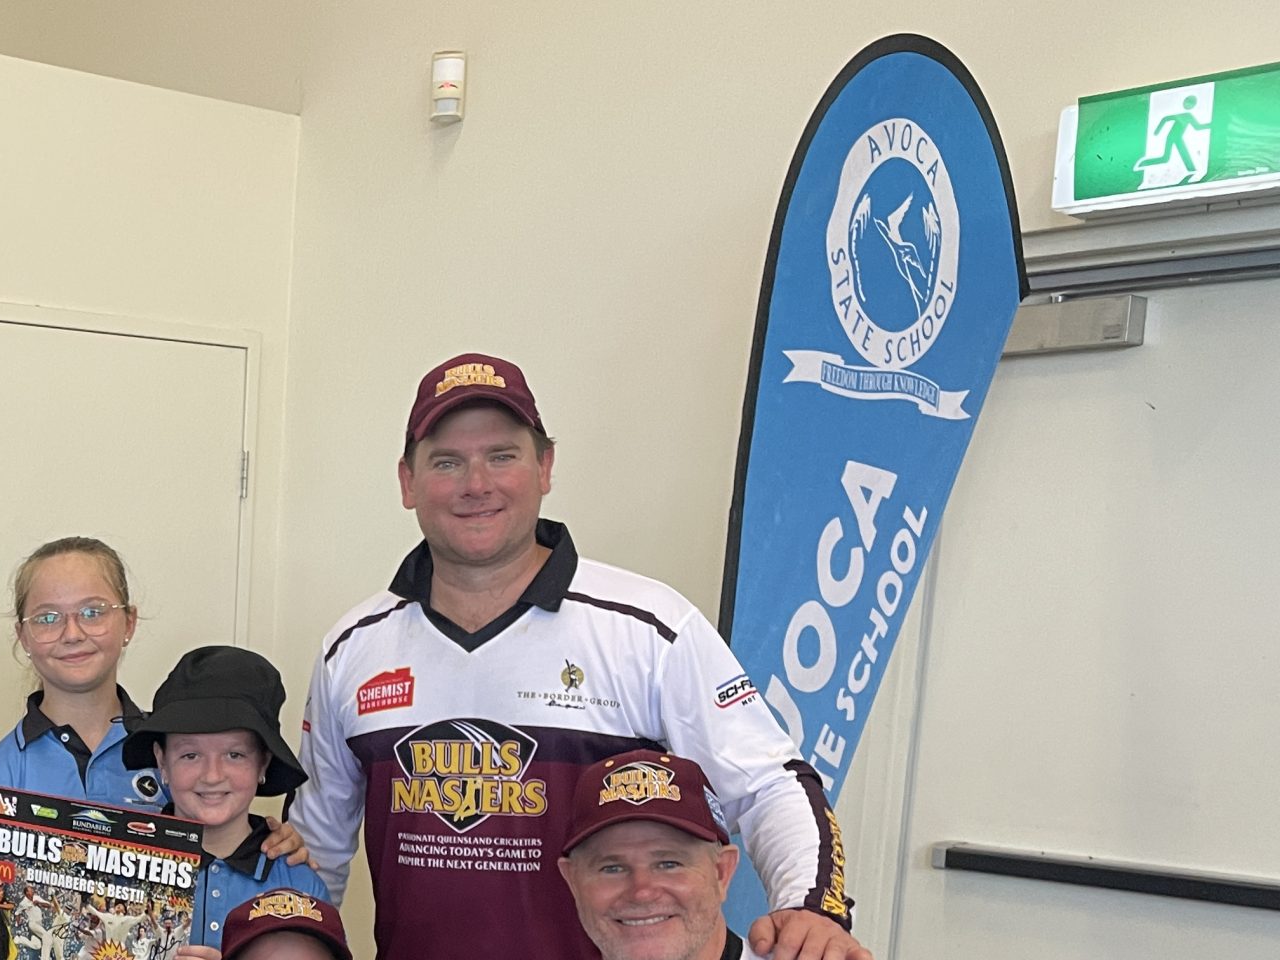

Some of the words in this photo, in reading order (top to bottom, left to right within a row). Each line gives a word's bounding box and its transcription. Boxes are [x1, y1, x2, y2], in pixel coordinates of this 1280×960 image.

[867, 122, 939, 186] AVOCA
[831, 247, 874, 352] STATE
[884, 280, 954, 364] SCHOOL
[822, 363, 857, 389] FREEDOM
[858, 370, 892, 392] THROUGH
[894, 374, 936, 404] KNOWLEDGE
[836, 505, 928, 722] SCHOOL
[359, 681, 411, 703] CHEMIST
[517, 691, 536, 699] THE
[543, 692, 583, 703] BORDER
[410, 739, 523, 777] BULLS
[391, 778, 548, 819] MASTERS
[437, 835, 492, 846] QUEENSLAND
[449, 846, 494, 858] TODAY'S
[496, 848, 527, 859] GAME
[528, 849, 542, 859] TO
[85, 844, 193, 890] MASTERS
[427, 857, 445, 869] THE
[446, 858, 473, 870] NEXT
[474, 860, 541, 872] GENERATION
[25, 867, 106, 896] BUNDABERG'S
[108, 883, 144, 904] BEST!!
